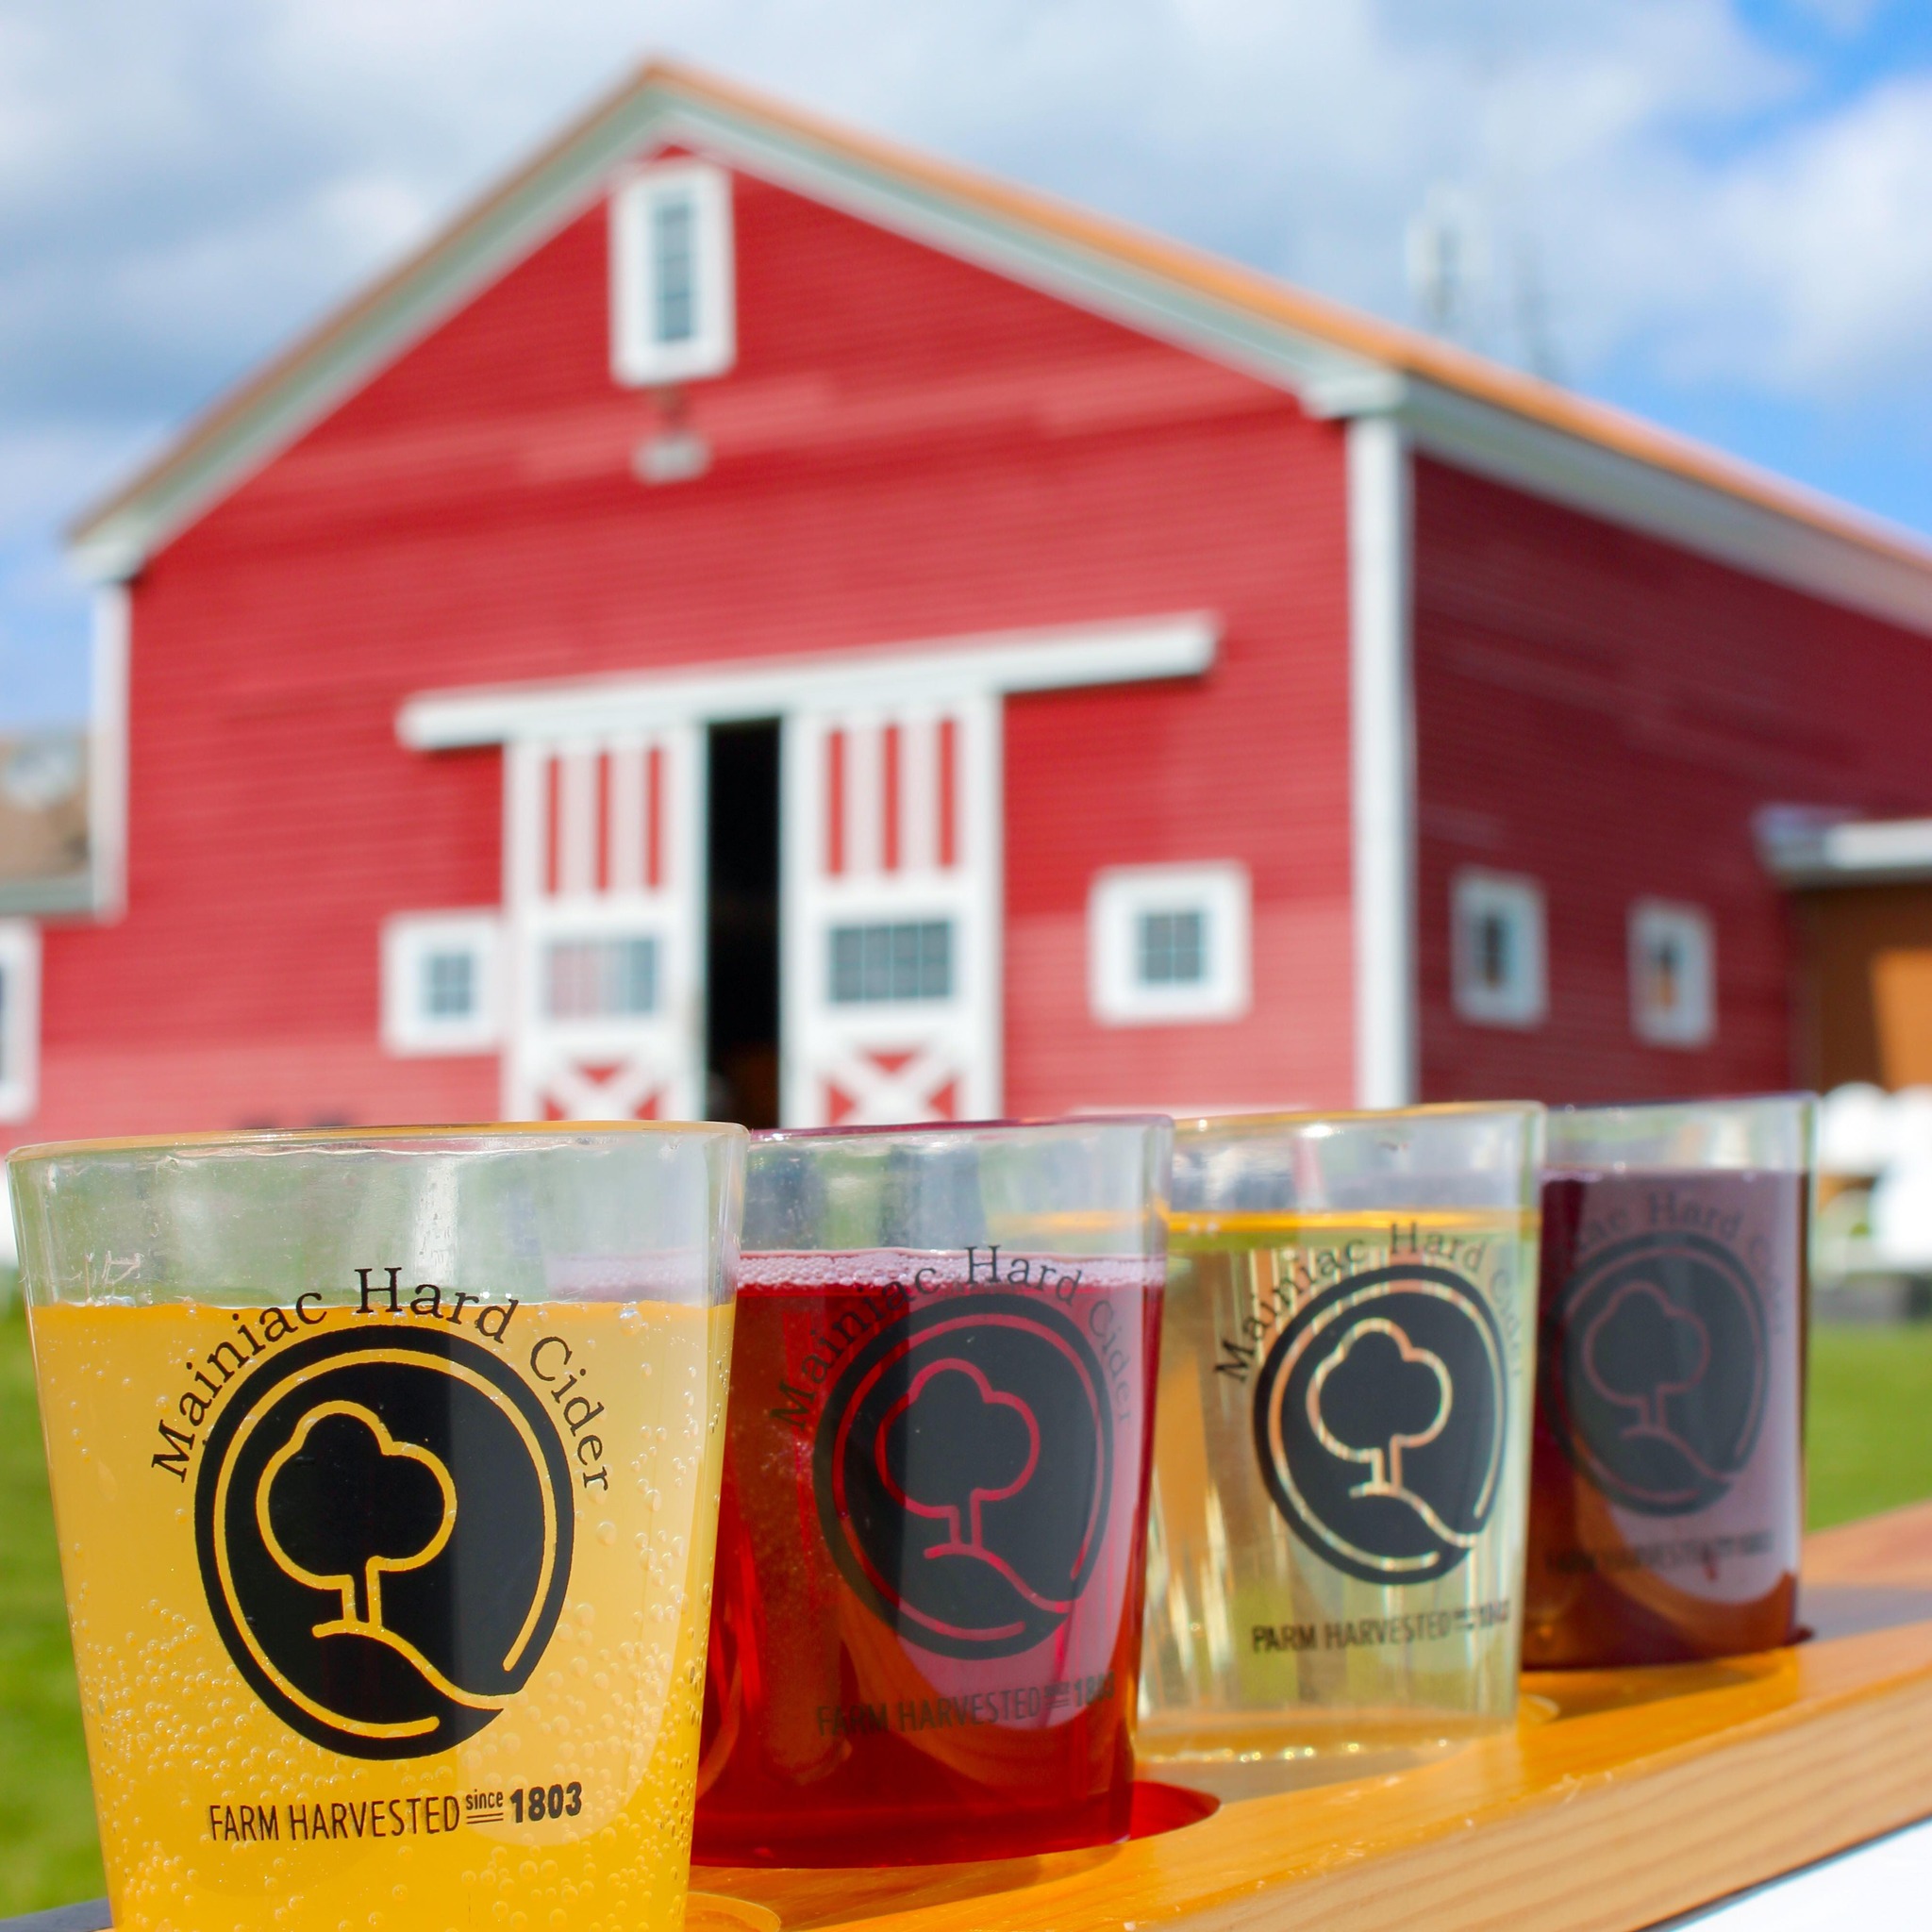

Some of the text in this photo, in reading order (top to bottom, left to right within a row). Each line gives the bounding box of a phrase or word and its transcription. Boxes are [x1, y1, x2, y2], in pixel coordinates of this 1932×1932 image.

[769, 1268, 941, 1432] Mainiac
[963, 1244, 1083, 1307] Hard
[1213, 1239, 1365, 1384] Mainiac
[1389, 1222, 1488, 1273] Hard
[150, 1266, 608, 1491] Mainiac Hard Cider
[1324, 1610, 1452, 1649] HARVESTED
[816, 1703, 890, 1737] FARM
[898, 1686, 1039, 1733] HARVESTED
[208, 1781, 583, 1842] FARM HARVESTED since 1803
